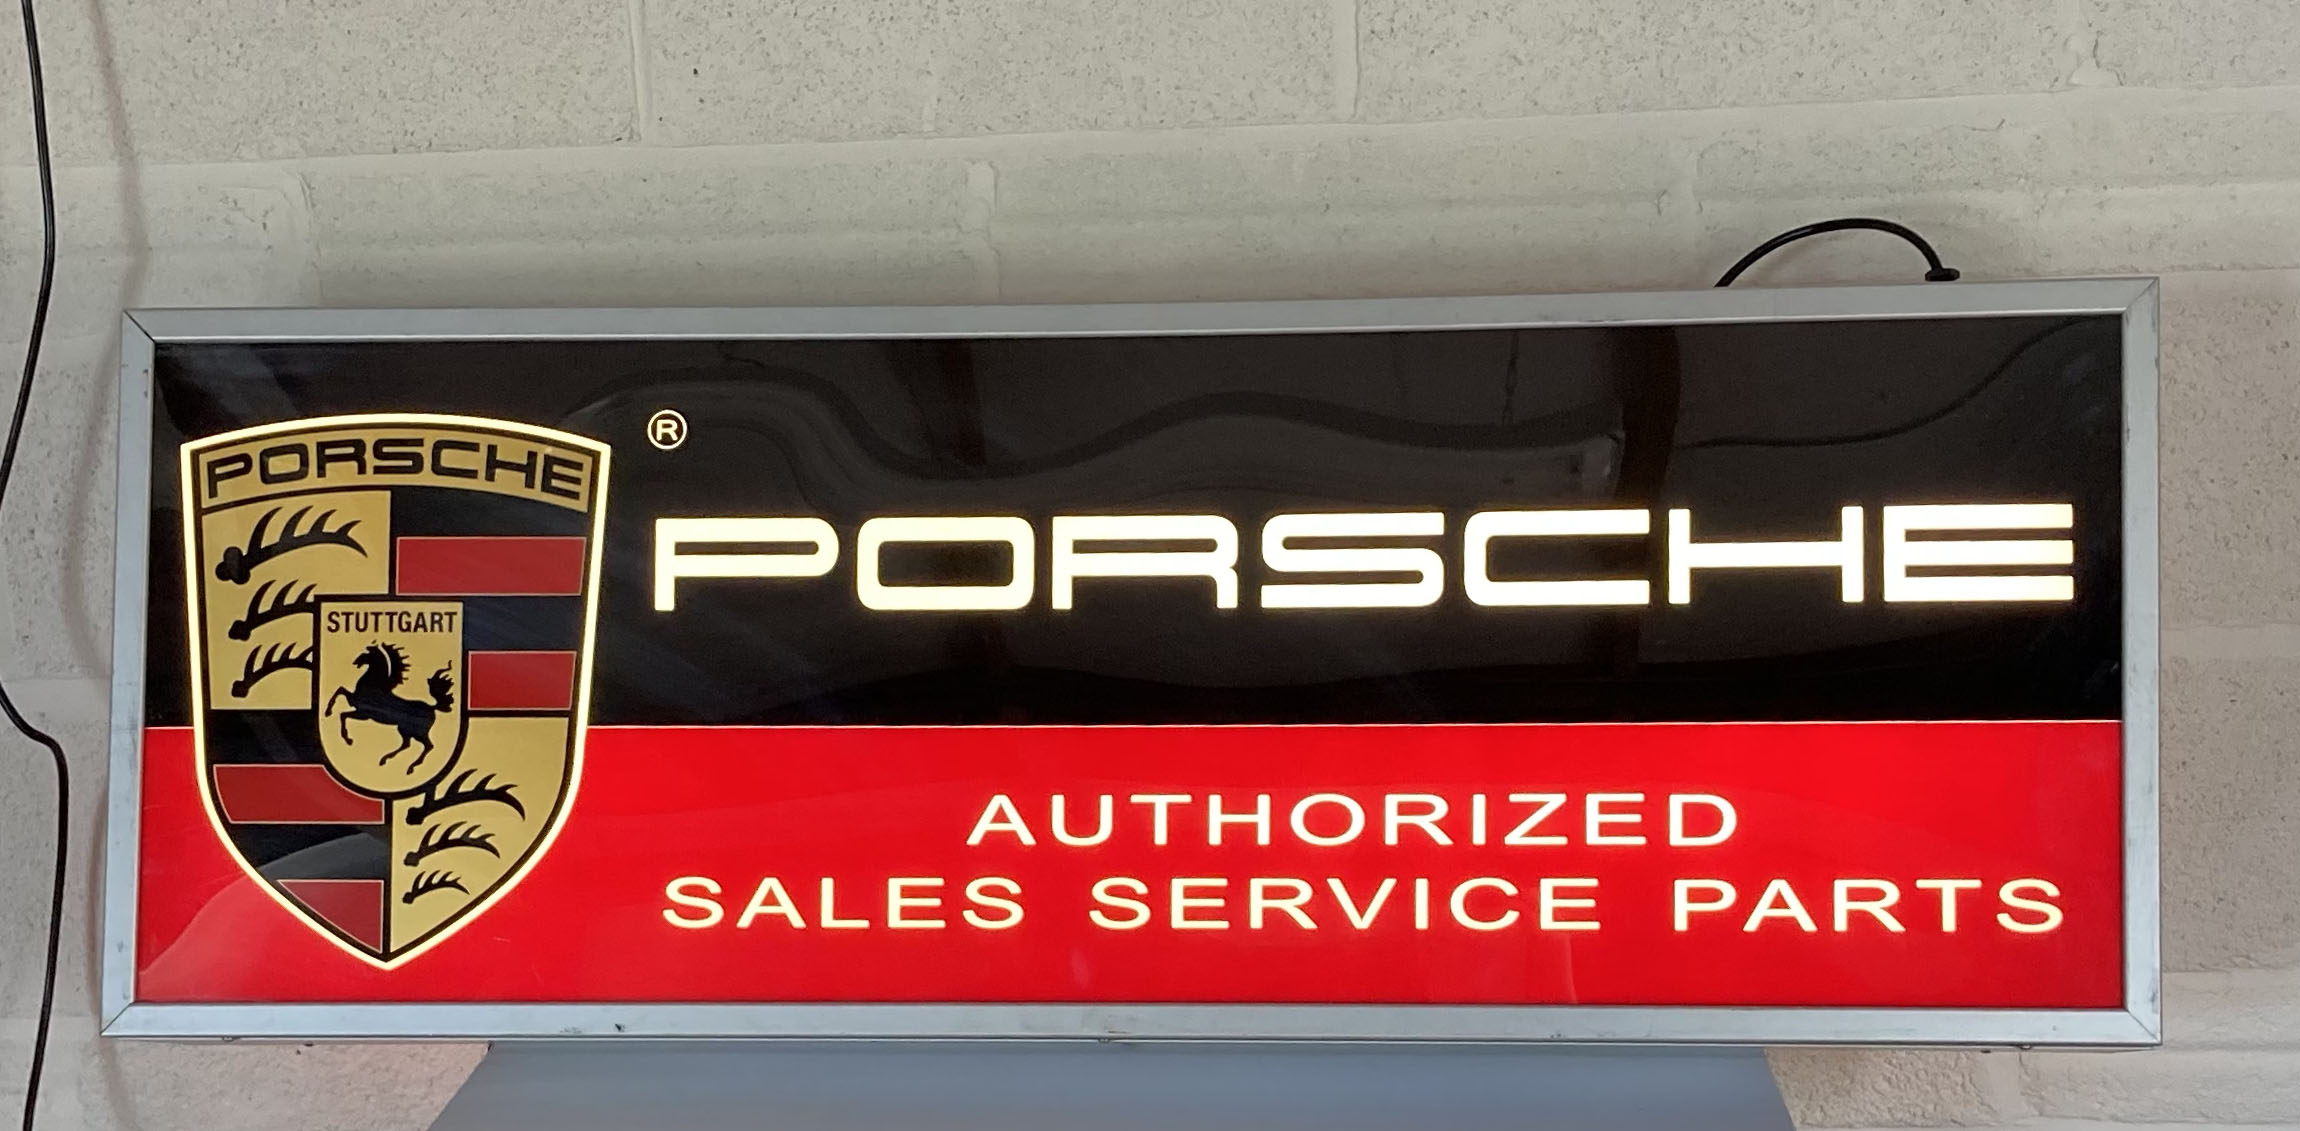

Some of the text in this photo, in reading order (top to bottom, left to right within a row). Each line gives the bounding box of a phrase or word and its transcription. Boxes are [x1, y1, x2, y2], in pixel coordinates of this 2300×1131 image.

[206, 437, 590, 501] PORSCHE
[653, 503, 2075, 612] PORSCHE
[326, 611, 459, 635] STUTTGART
[967, 792, 1737, 847] AUTHORIZED
[662, 876, 2063, 933] SALES SERVICE PARTS
